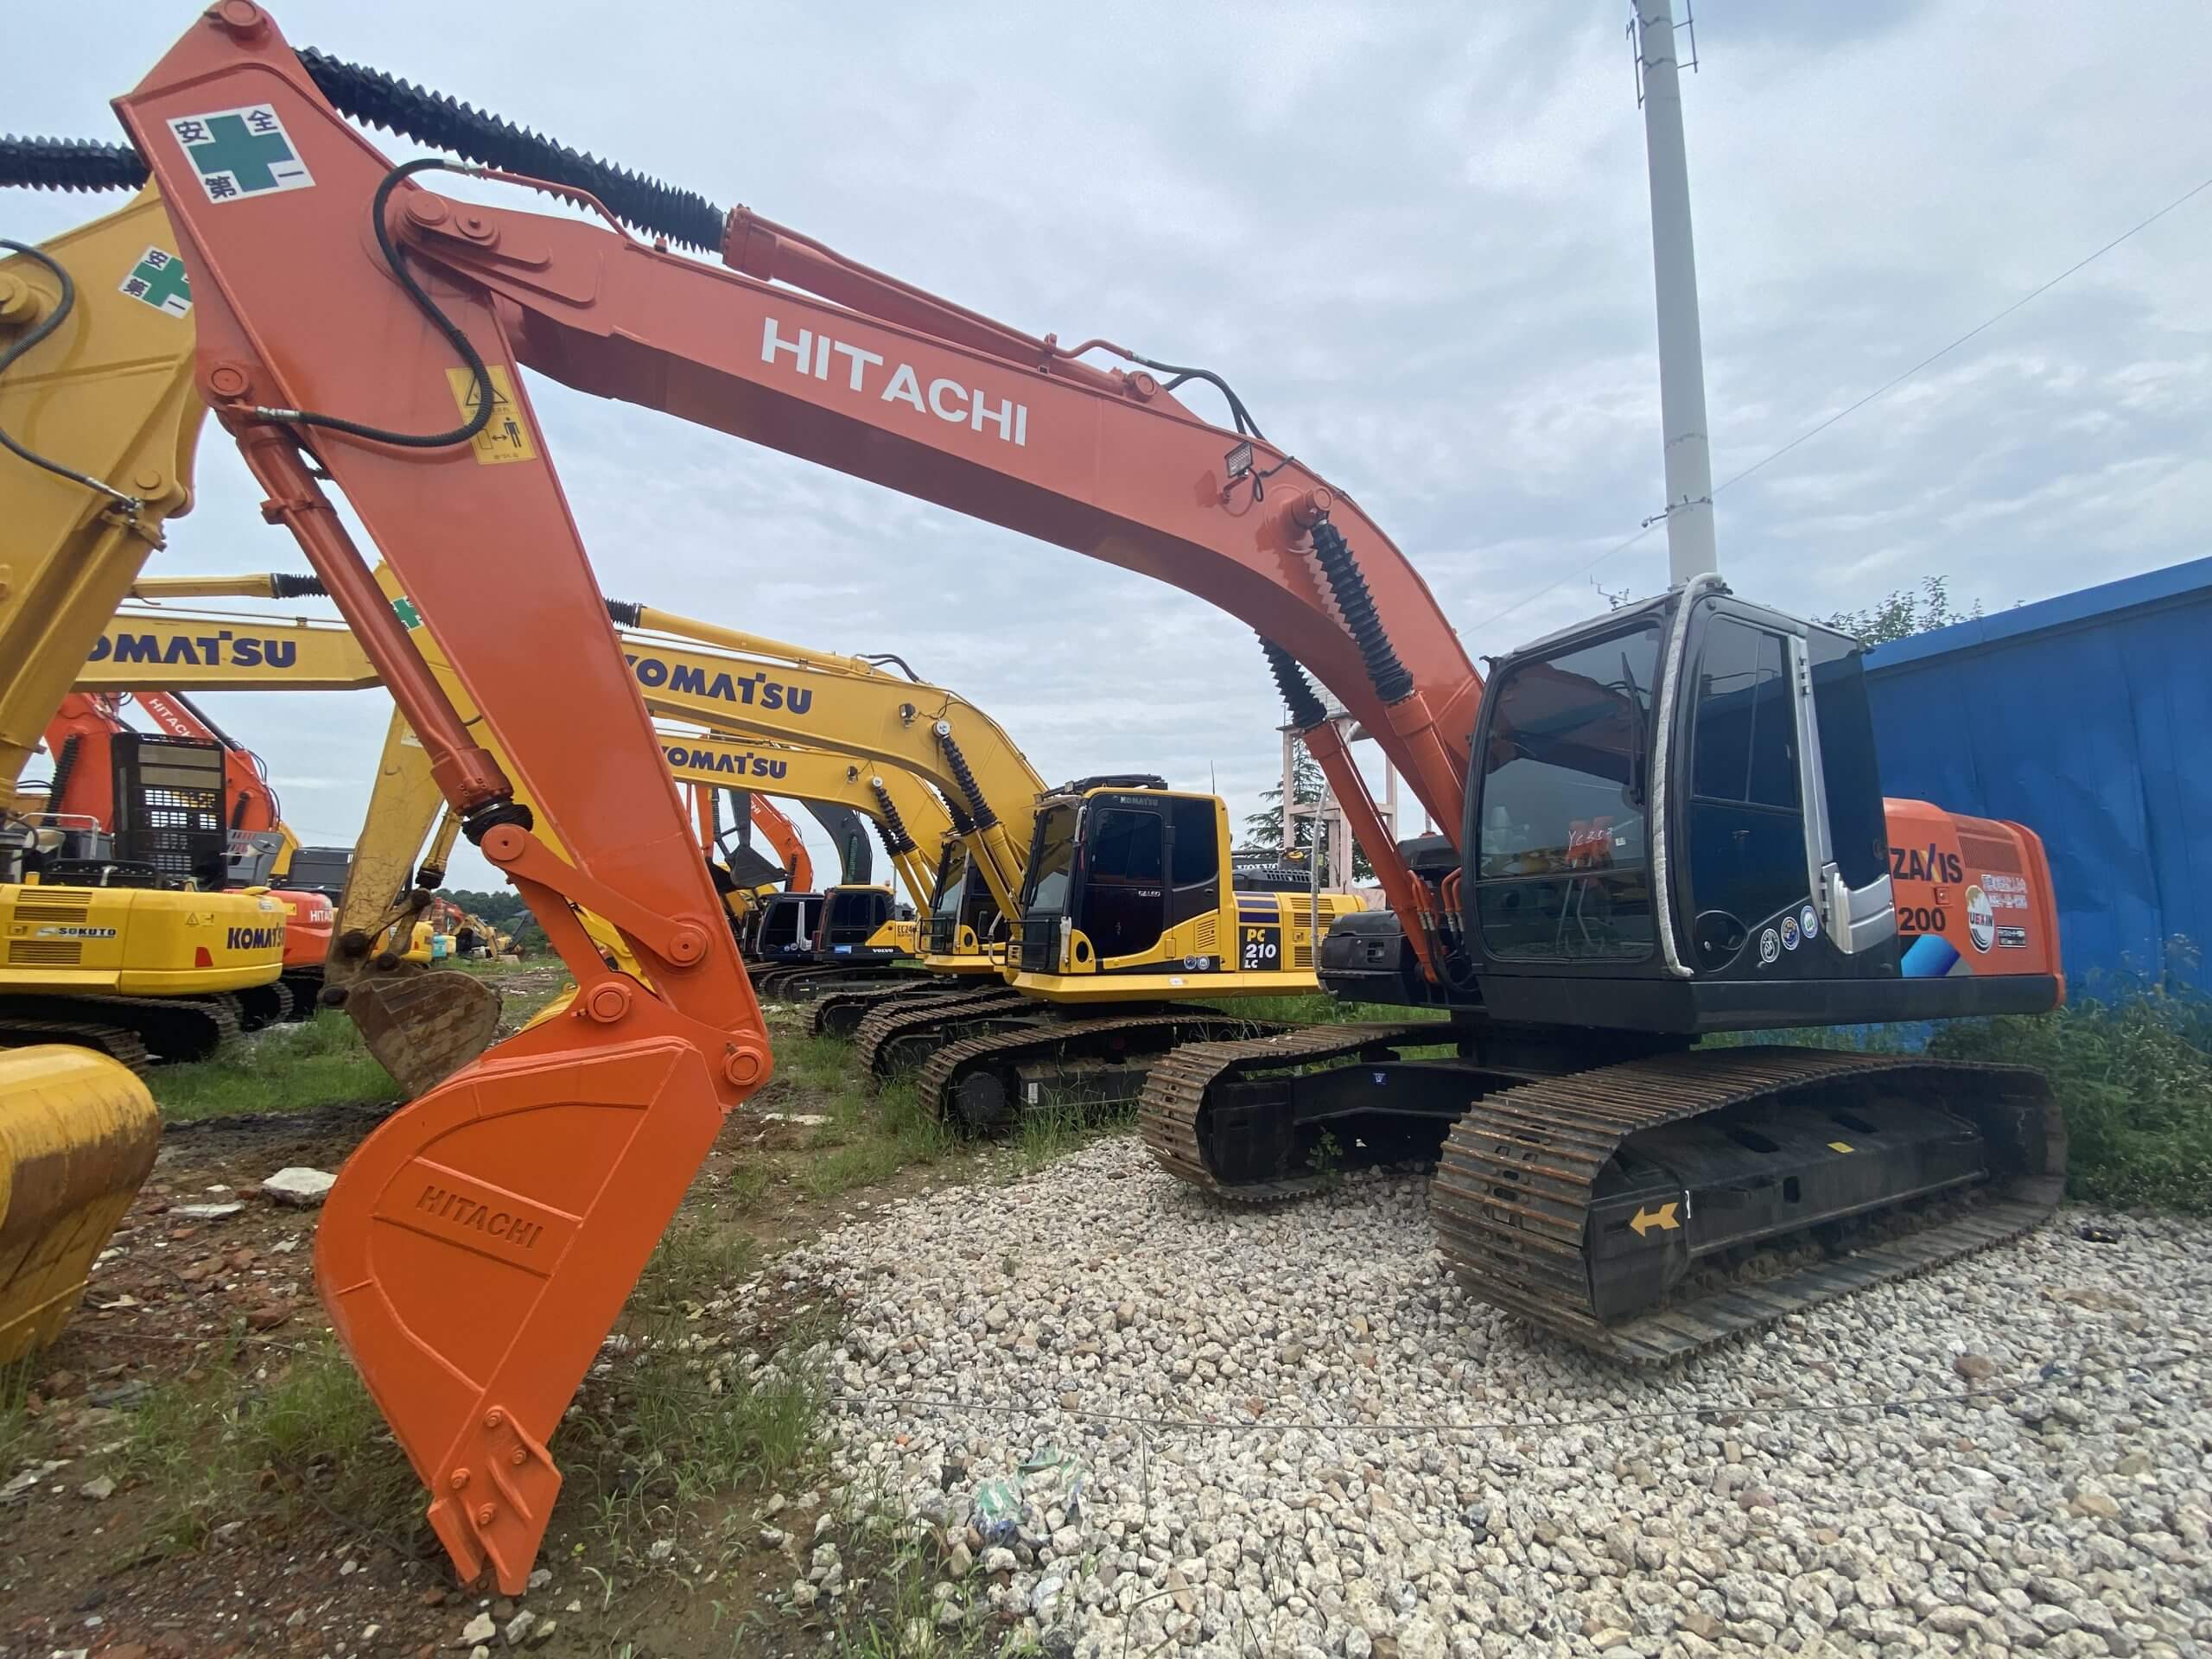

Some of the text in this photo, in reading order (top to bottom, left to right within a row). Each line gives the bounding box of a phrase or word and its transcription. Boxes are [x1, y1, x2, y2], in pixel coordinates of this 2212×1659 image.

[761, 316, 1028, 448] HITACHI
[87, 631, 296, 669] OMATSU
[1890, 843, 1963, 884] ZAXIS
[58, 927, 117, 936] SOKUTO
[1898, 907, 1946, 931] 200
[227, 922, 285, 950] KOMATS
[1246, 929, 1266, 942] PC
[1243, 959, 1259, 969] LC
[1245, 944, 1277, 958] 210
[415, 1185, 544, 1249] HITACHI
